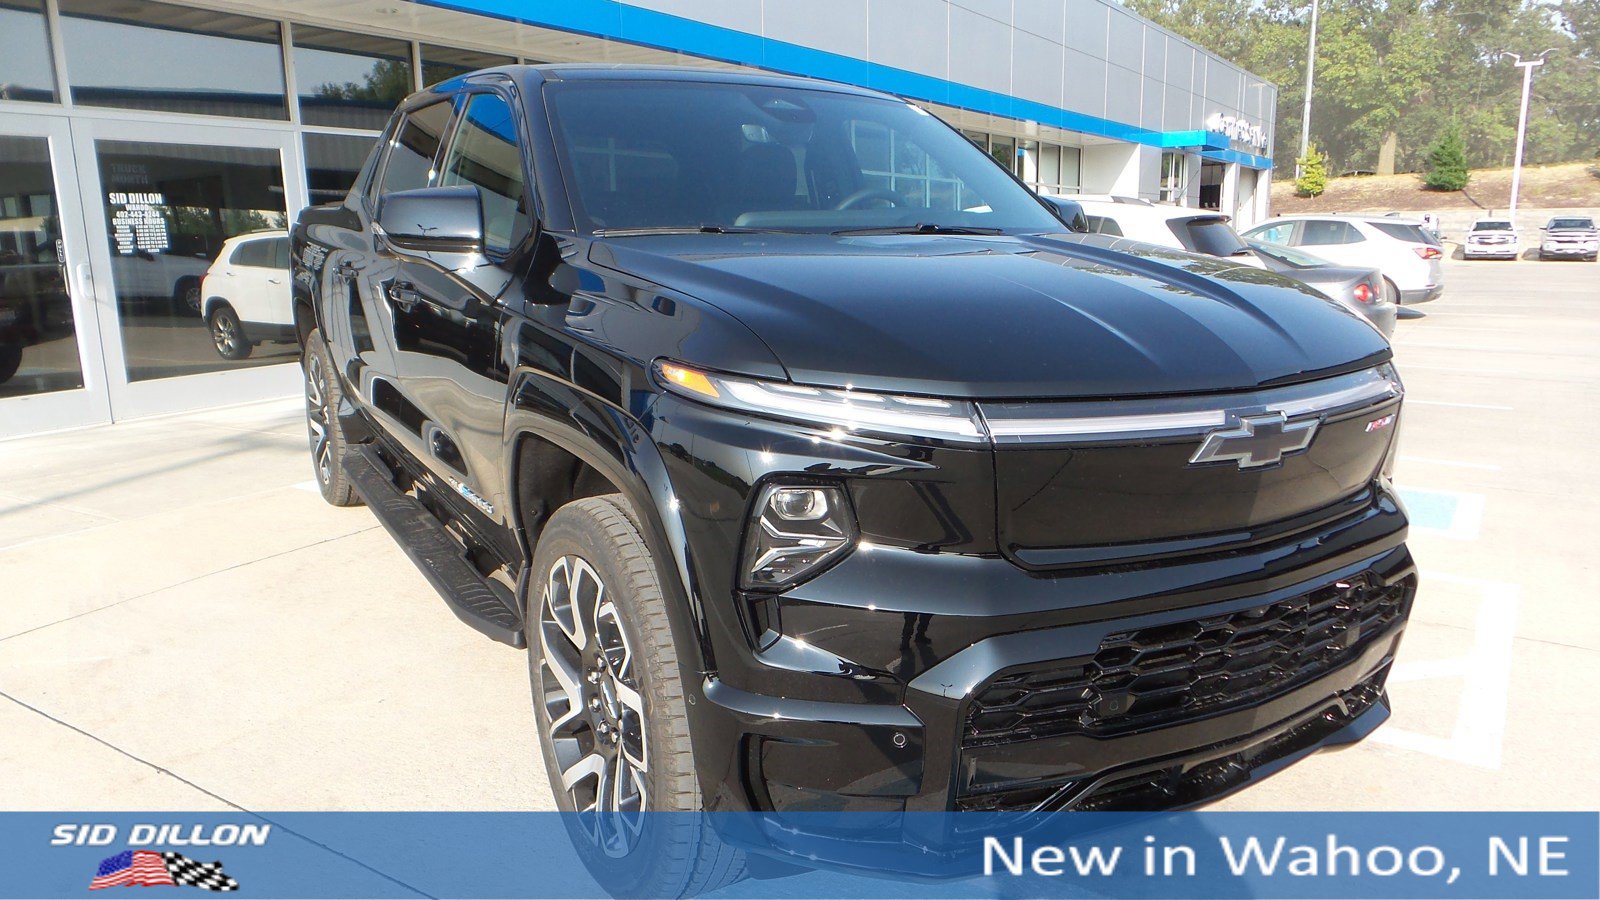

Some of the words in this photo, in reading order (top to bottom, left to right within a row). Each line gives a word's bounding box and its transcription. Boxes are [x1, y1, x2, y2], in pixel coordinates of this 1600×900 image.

[108, 192, 127, 204] SID
[128, 192, 163, 204] DILLON
[112, 217, 143, 225] BUSINESS
[144, 217, 165, 225] HOURS
